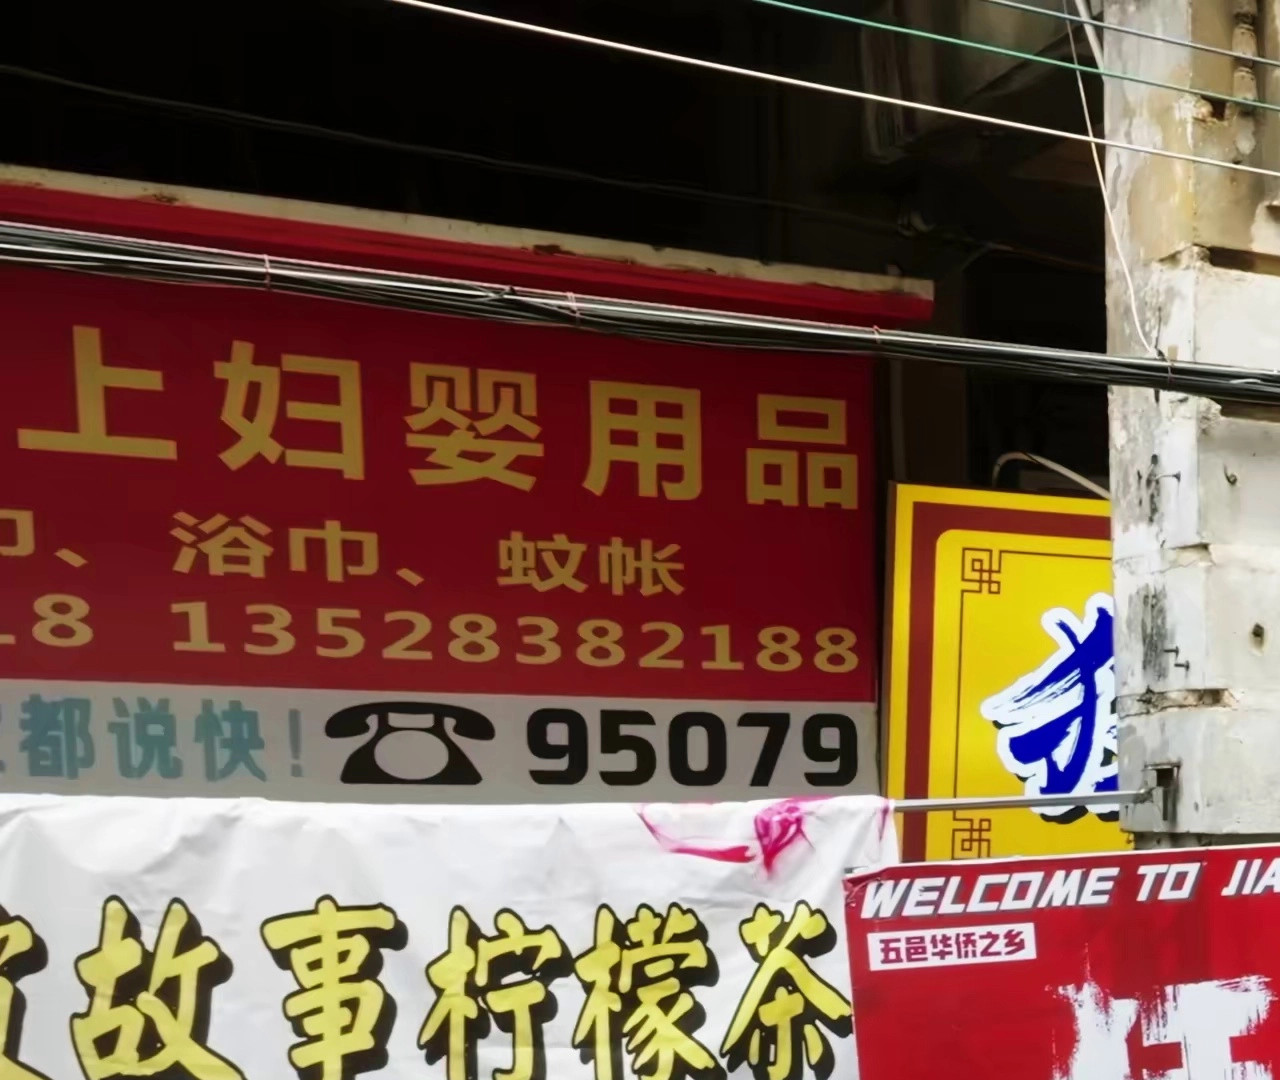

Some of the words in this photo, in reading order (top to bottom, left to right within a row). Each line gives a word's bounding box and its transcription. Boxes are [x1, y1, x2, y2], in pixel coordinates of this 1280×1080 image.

[17, 325, 859, 510] 上妇婴用品
[170, 600, 860, 674] 13528382188
[0, 692, 305, 783] 都说快!
[526, 706, 860, 788] 95079
[860, 867, 1120, 920] WELCOME
[1136, 861, 1201, 902] TO
[878, 928, 1027, 966] 五邑华侨之乡
